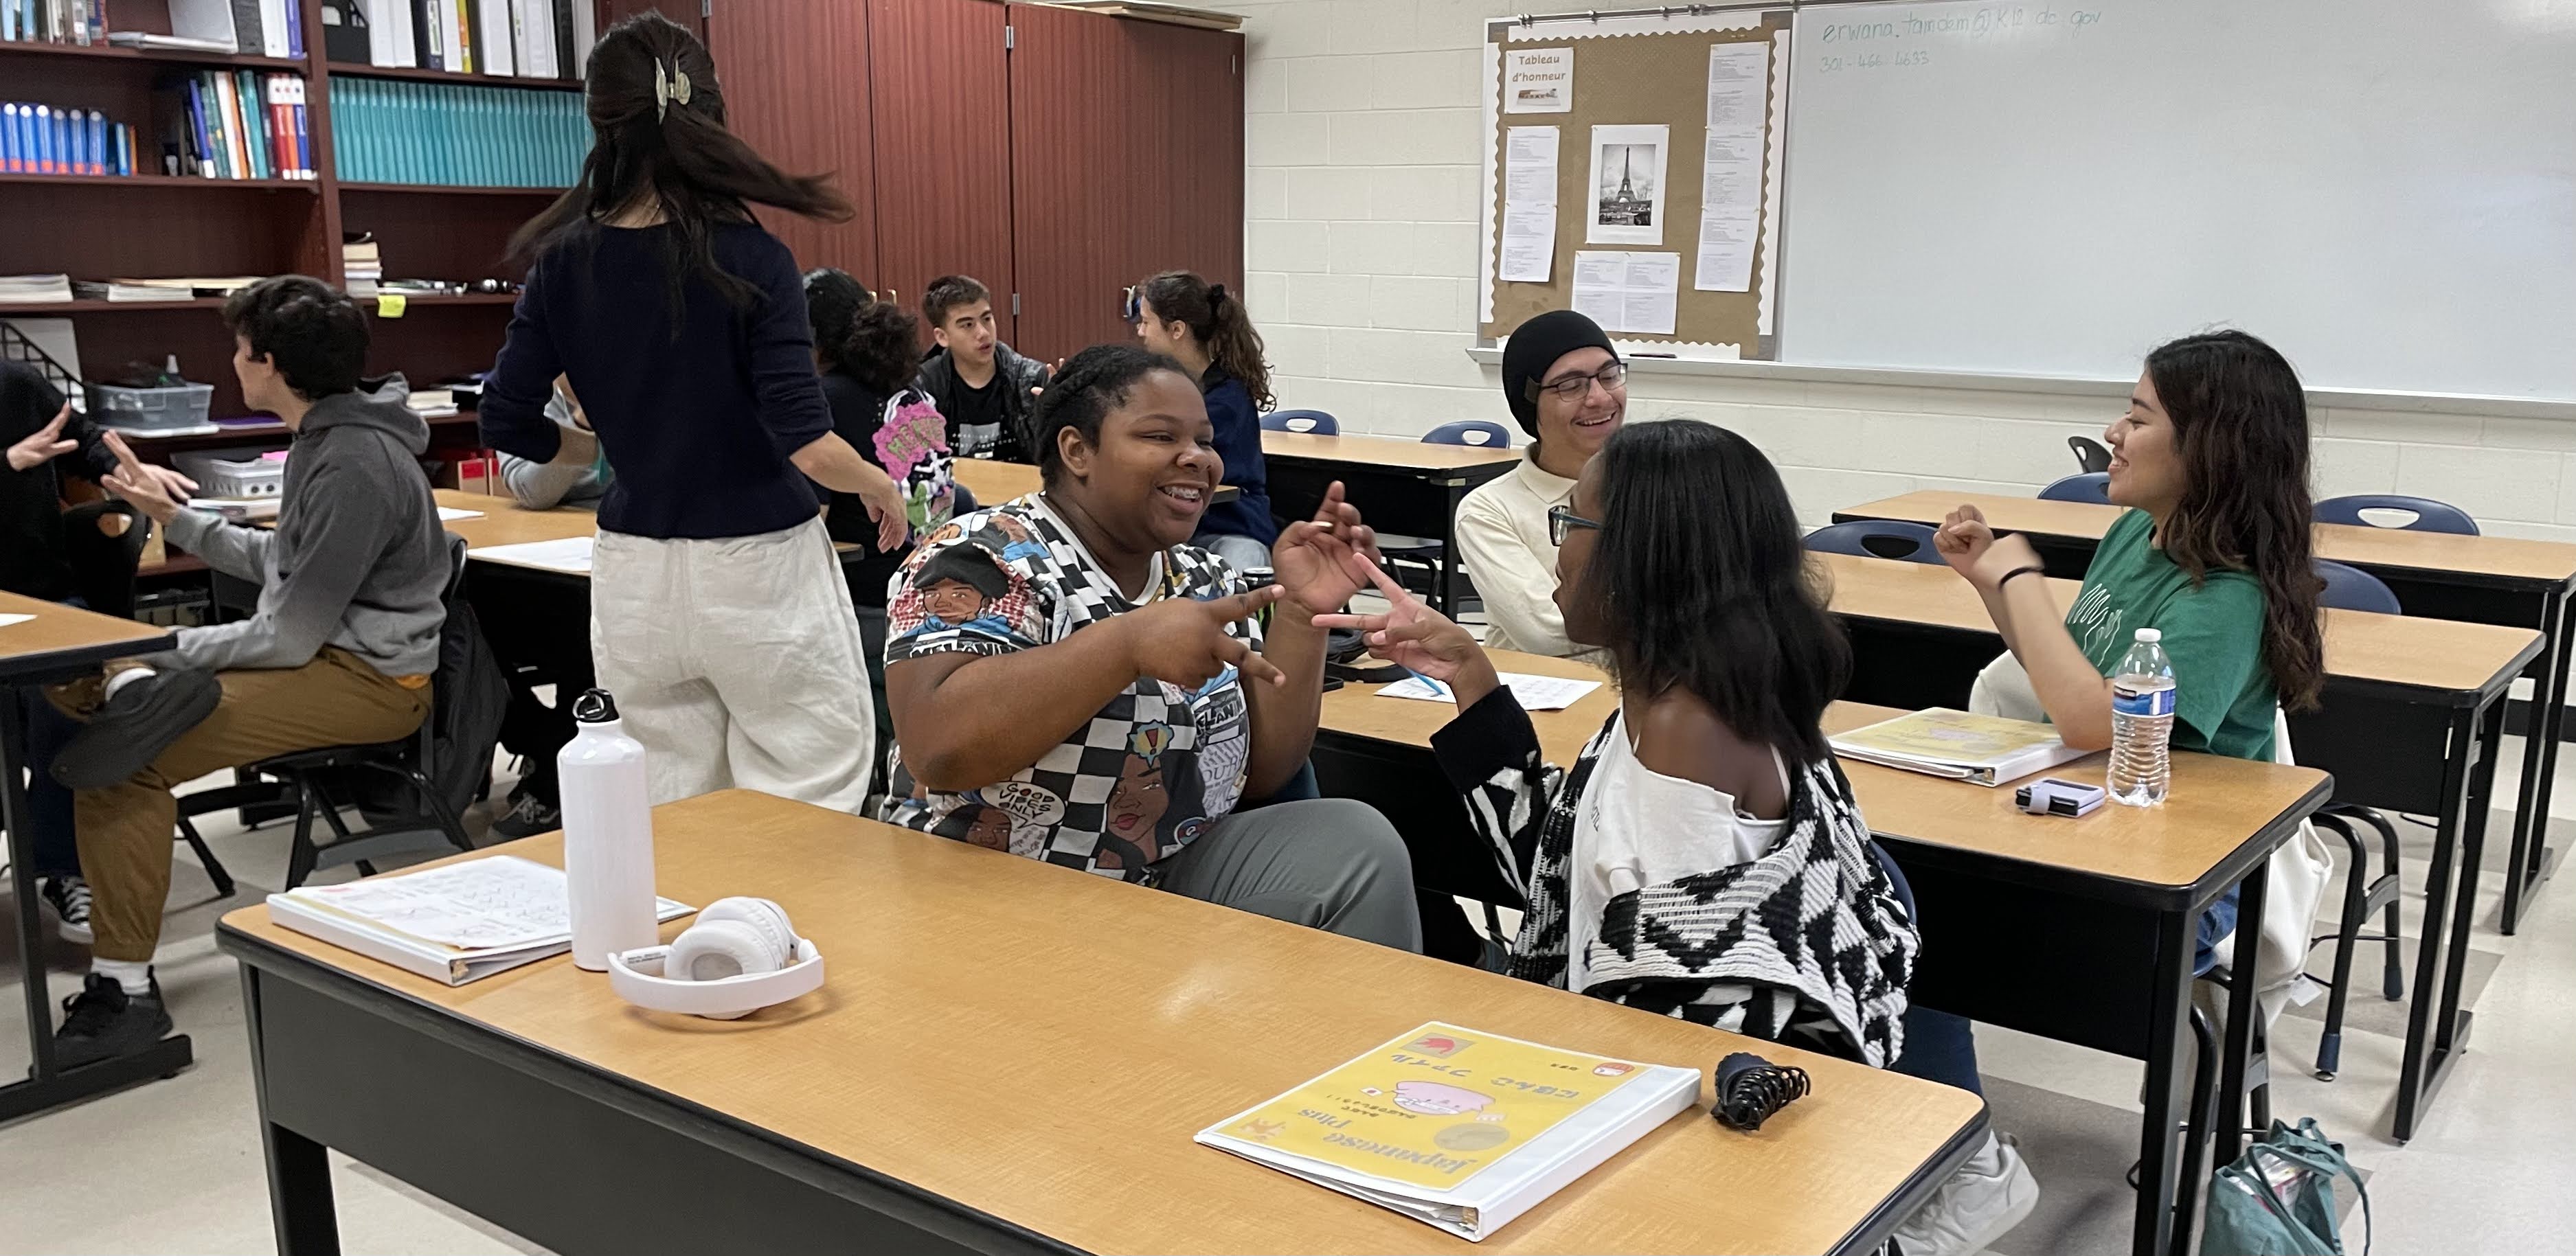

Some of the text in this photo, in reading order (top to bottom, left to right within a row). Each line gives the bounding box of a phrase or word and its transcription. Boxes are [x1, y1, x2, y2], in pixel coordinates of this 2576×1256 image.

[1519, 55, 1560, 65] Tableau
[1512, 73, 1566, 82] d'honneur
[999, 790, 1052, 812] VIBES
[1007, 784, 1055, 803] GOOD
[998, 801, 1044, 819] ONLY
[1298, 1109, 1352, 1129] Plus
[1323, 1133, 1479, 1174] Japanese
